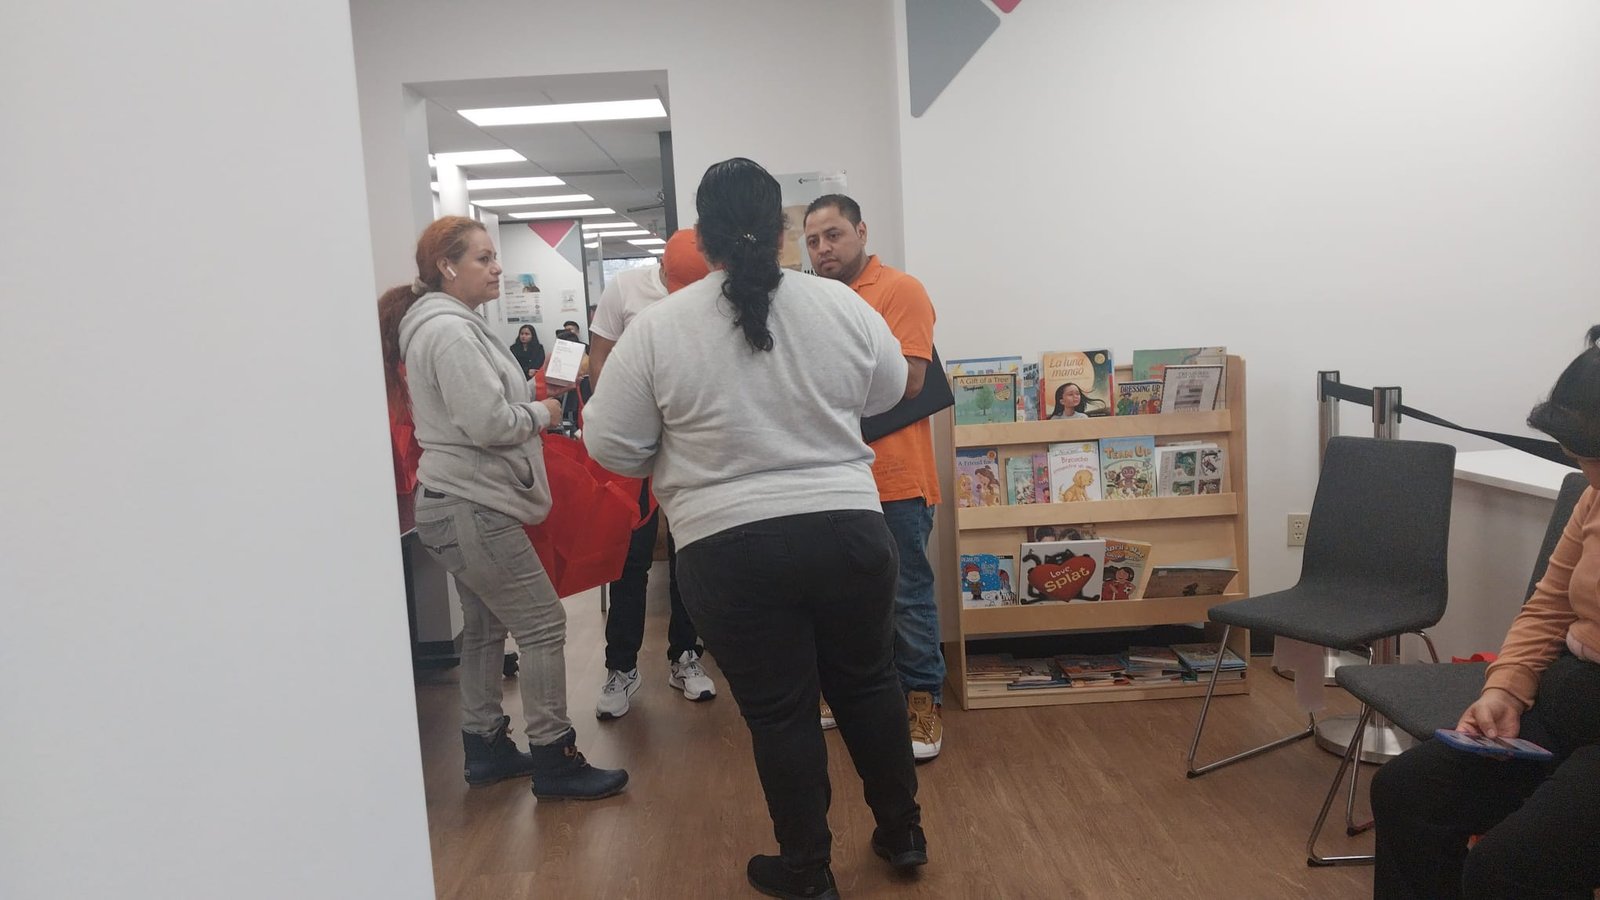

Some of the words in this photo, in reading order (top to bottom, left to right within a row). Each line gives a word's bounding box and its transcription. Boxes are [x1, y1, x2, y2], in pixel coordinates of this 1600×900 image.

[1049, 359, 1061, 368] La
[1063, 355, 1085, 368] luna
[1051, 367, 1085, 378] mango
[1120, 385, 1151, 393] DRESSING
[1151, 384, 1161, 393] UP
[1044, 566, 1090, 593] Splat
